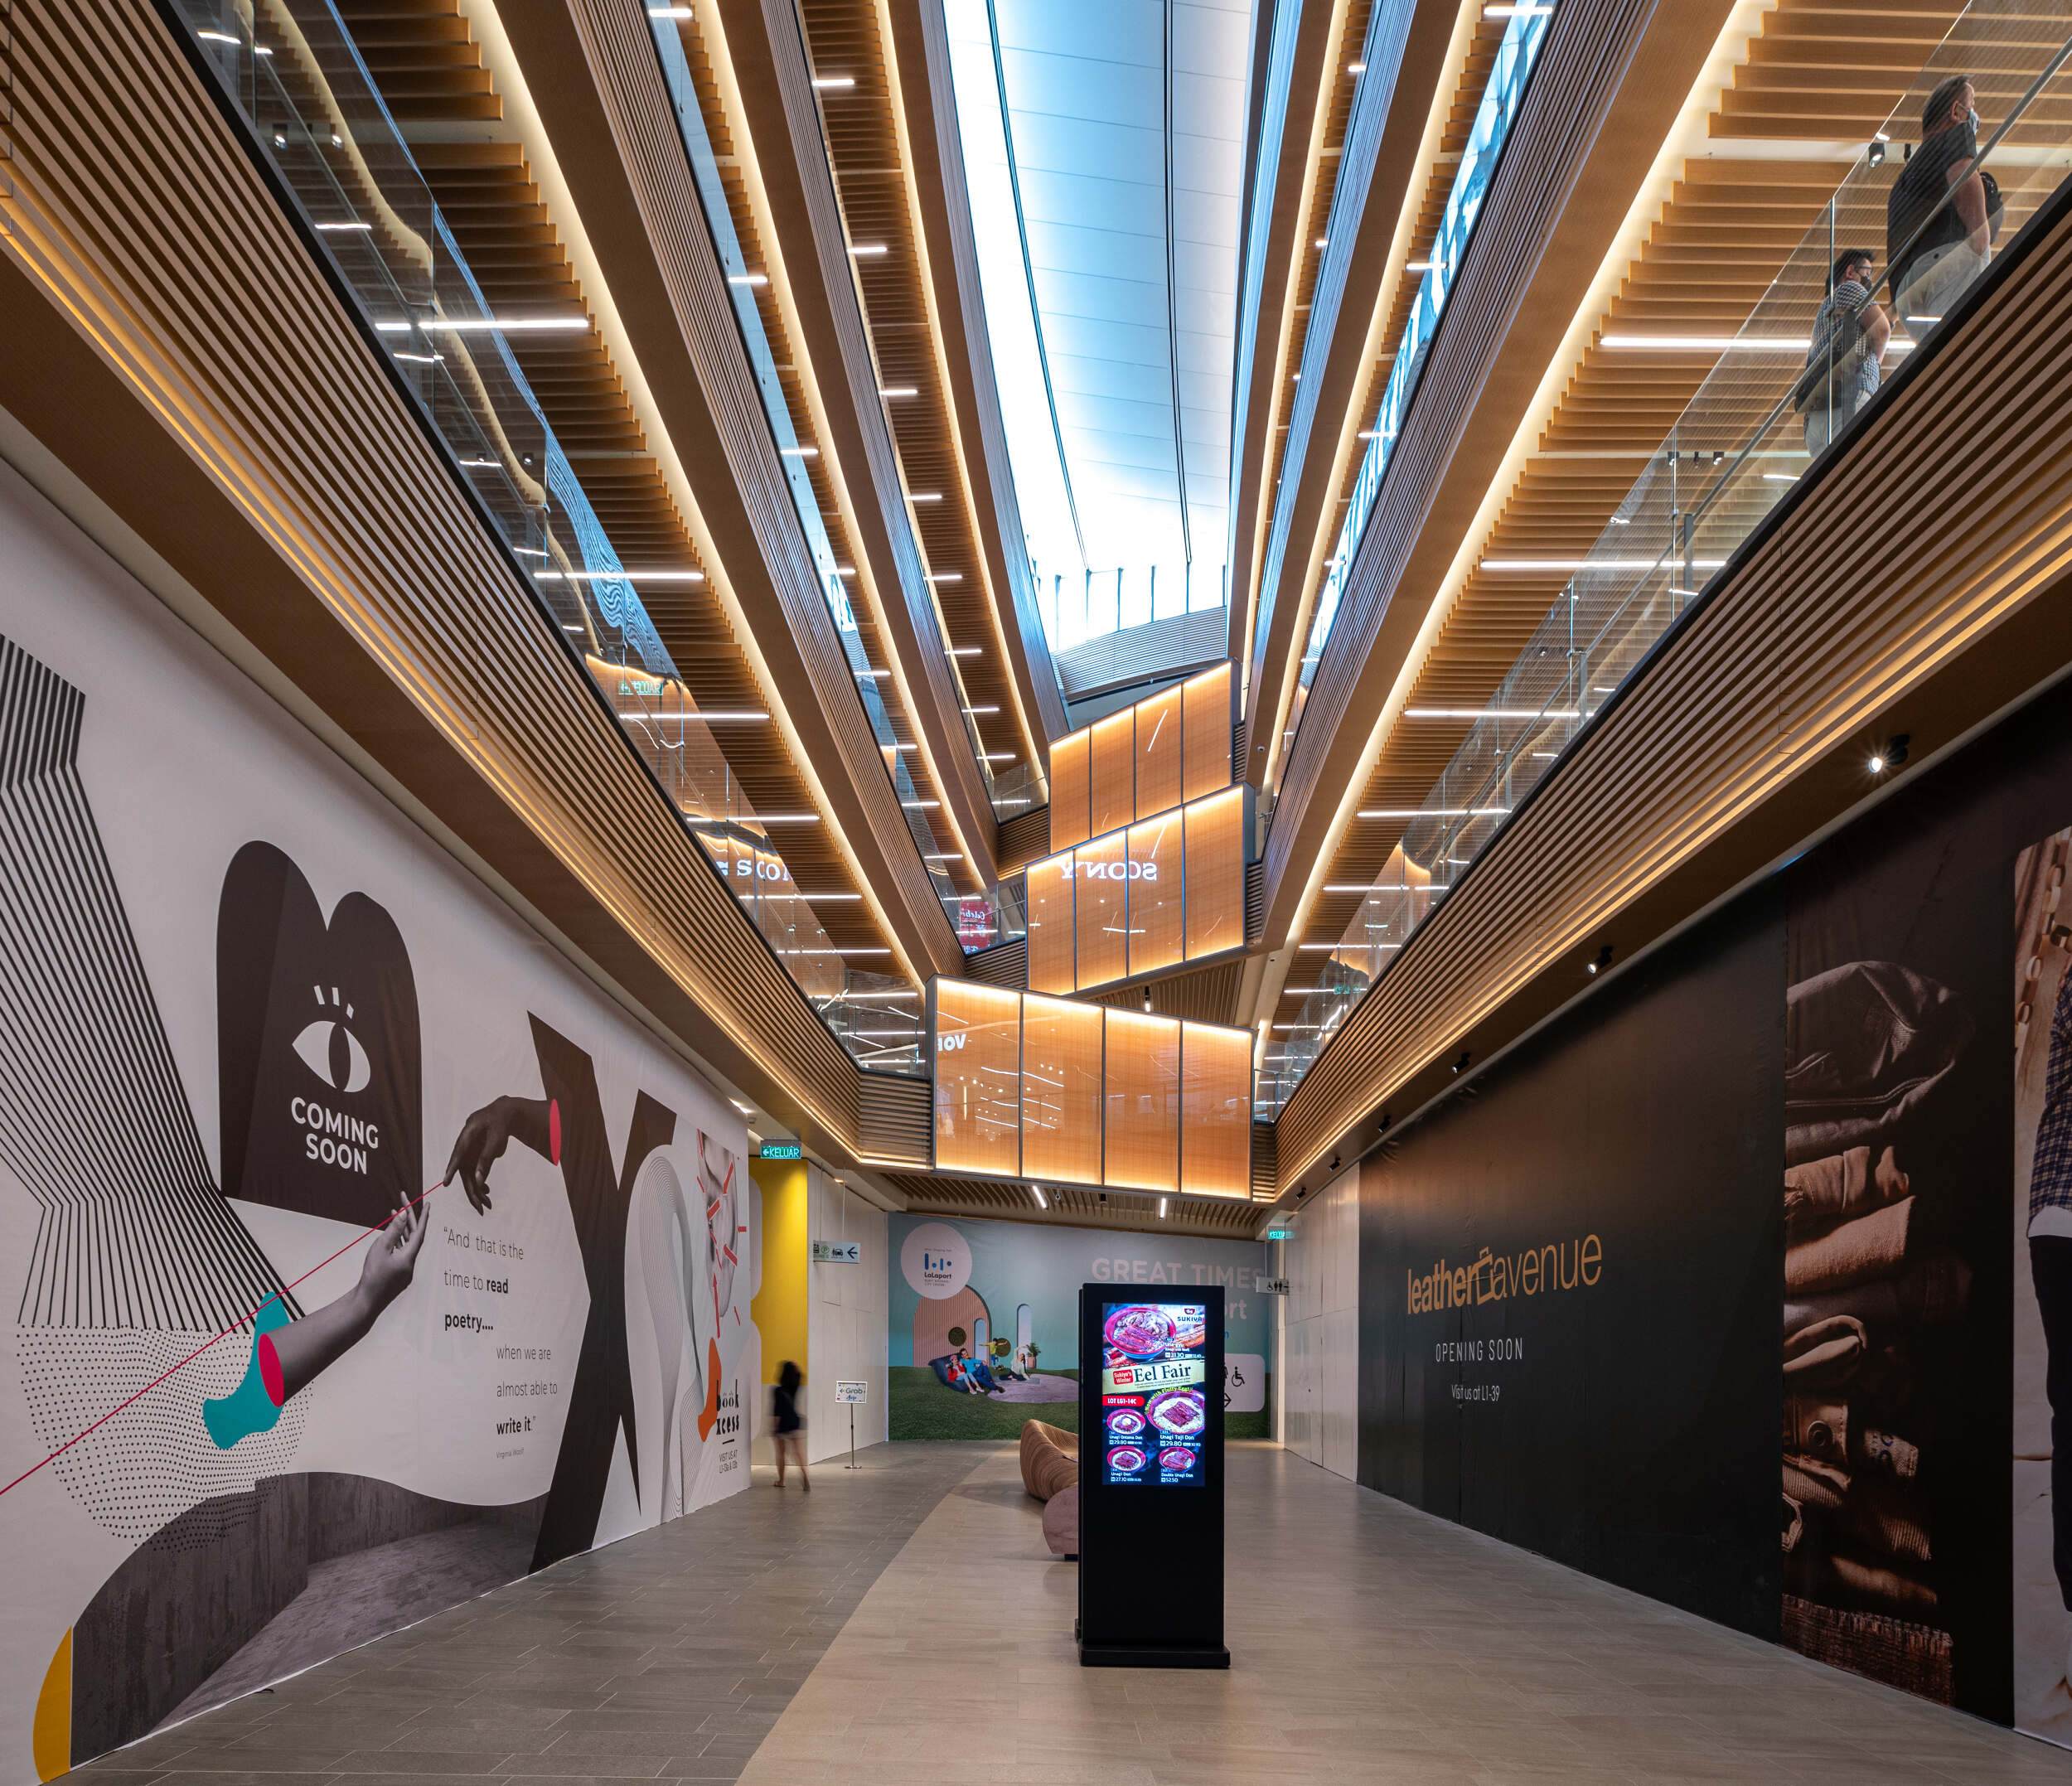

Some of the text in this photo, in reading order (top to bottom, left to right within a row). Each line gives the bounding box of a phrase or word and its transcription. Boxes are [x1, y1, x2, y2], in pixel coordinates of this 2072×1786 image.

[291, 1096, 379, 1149] COMING
[306, 1133, 367, 1174] SOON
[769, 1148, 800, 1158] KELUAR
[476, 1235, 496, 1255] that
[499, 1240, 506, 1256] is
[509, 1243, 524, 1260] the
[443, 1267, 509, 1294] time to read
[1092, 1258, 1182, 1284] GREAT
[496, 1344, 551, 1360] when we are
[1435, 1337, 1523, 1362] OPENING SOON
[1133, 1363, 1191, 1382] Eel Fair
[497, 1379, 558, 1397] almost able to
[1451, 1384, 1499, 1401] Visit us at L1-39
[496, 1416, 522, 1435] write
